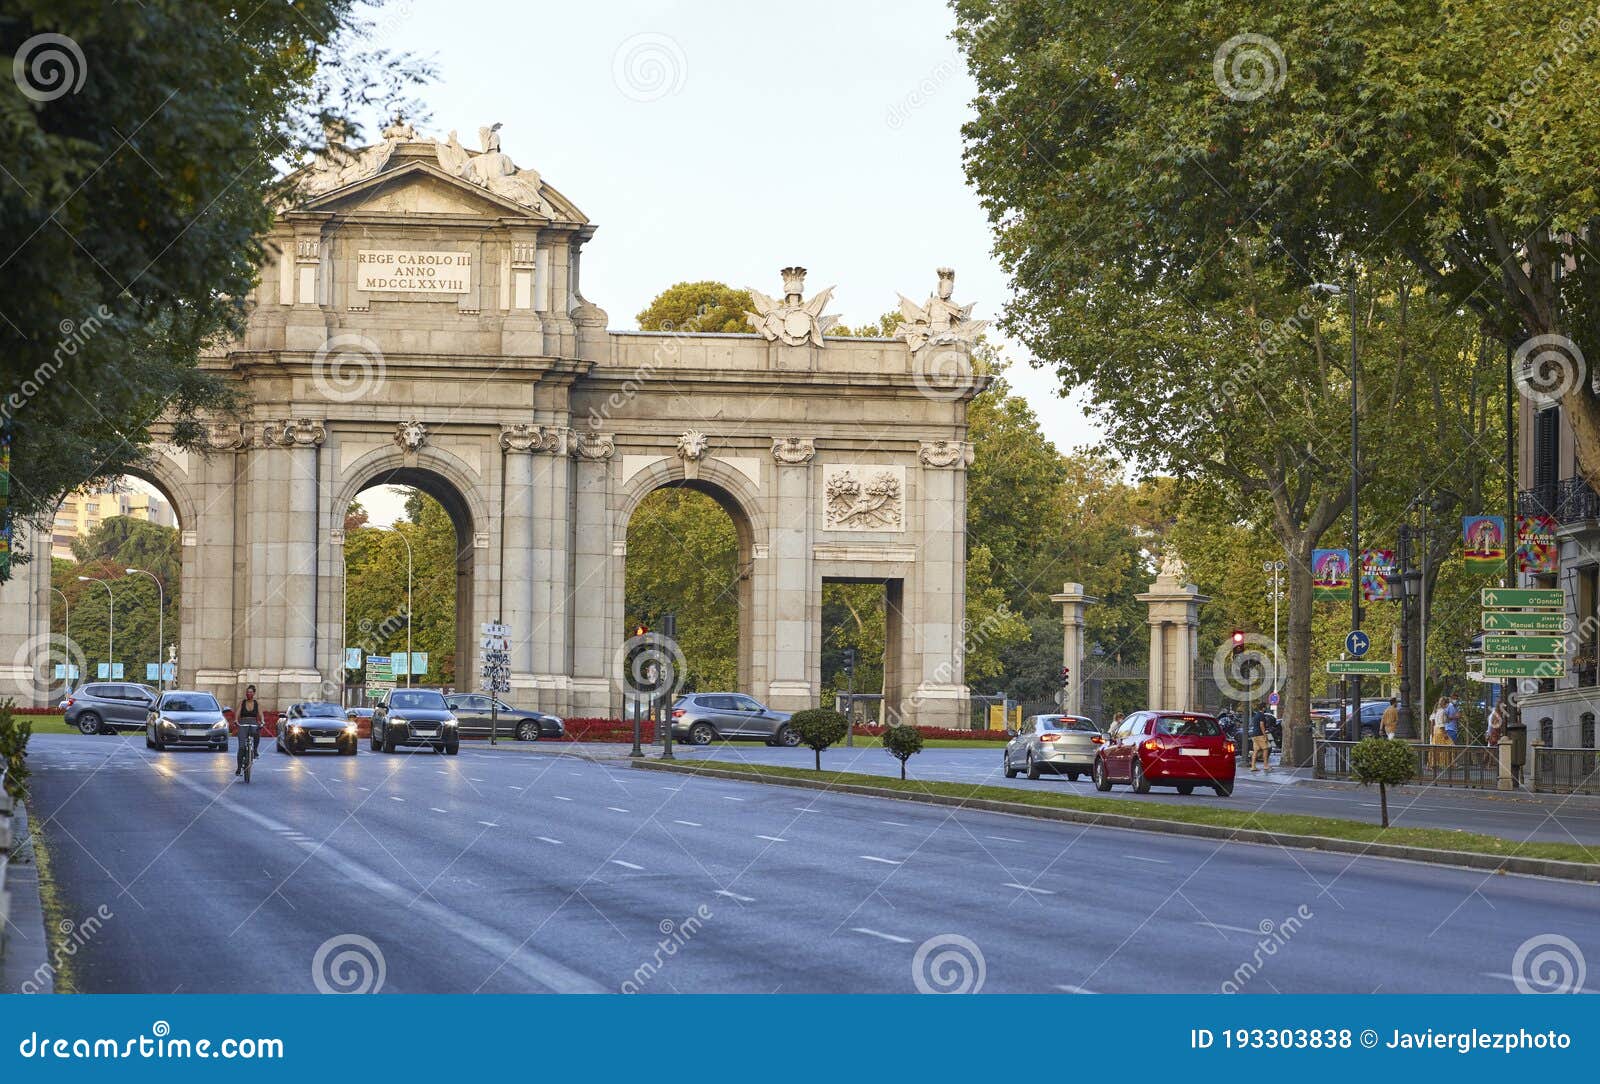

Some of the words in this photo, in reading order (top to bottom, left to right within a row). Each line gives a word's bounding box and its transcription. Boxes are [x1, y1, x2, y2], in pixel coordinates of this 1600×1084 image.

[359, 254, 394, 264] REGE
[398, 255, 453, 265] CAROLO
[457, 256, 472, 266] III
[394, 267, 436, 277] ANNO
[366, 278, 463, 290] MDCCLXXVIII
